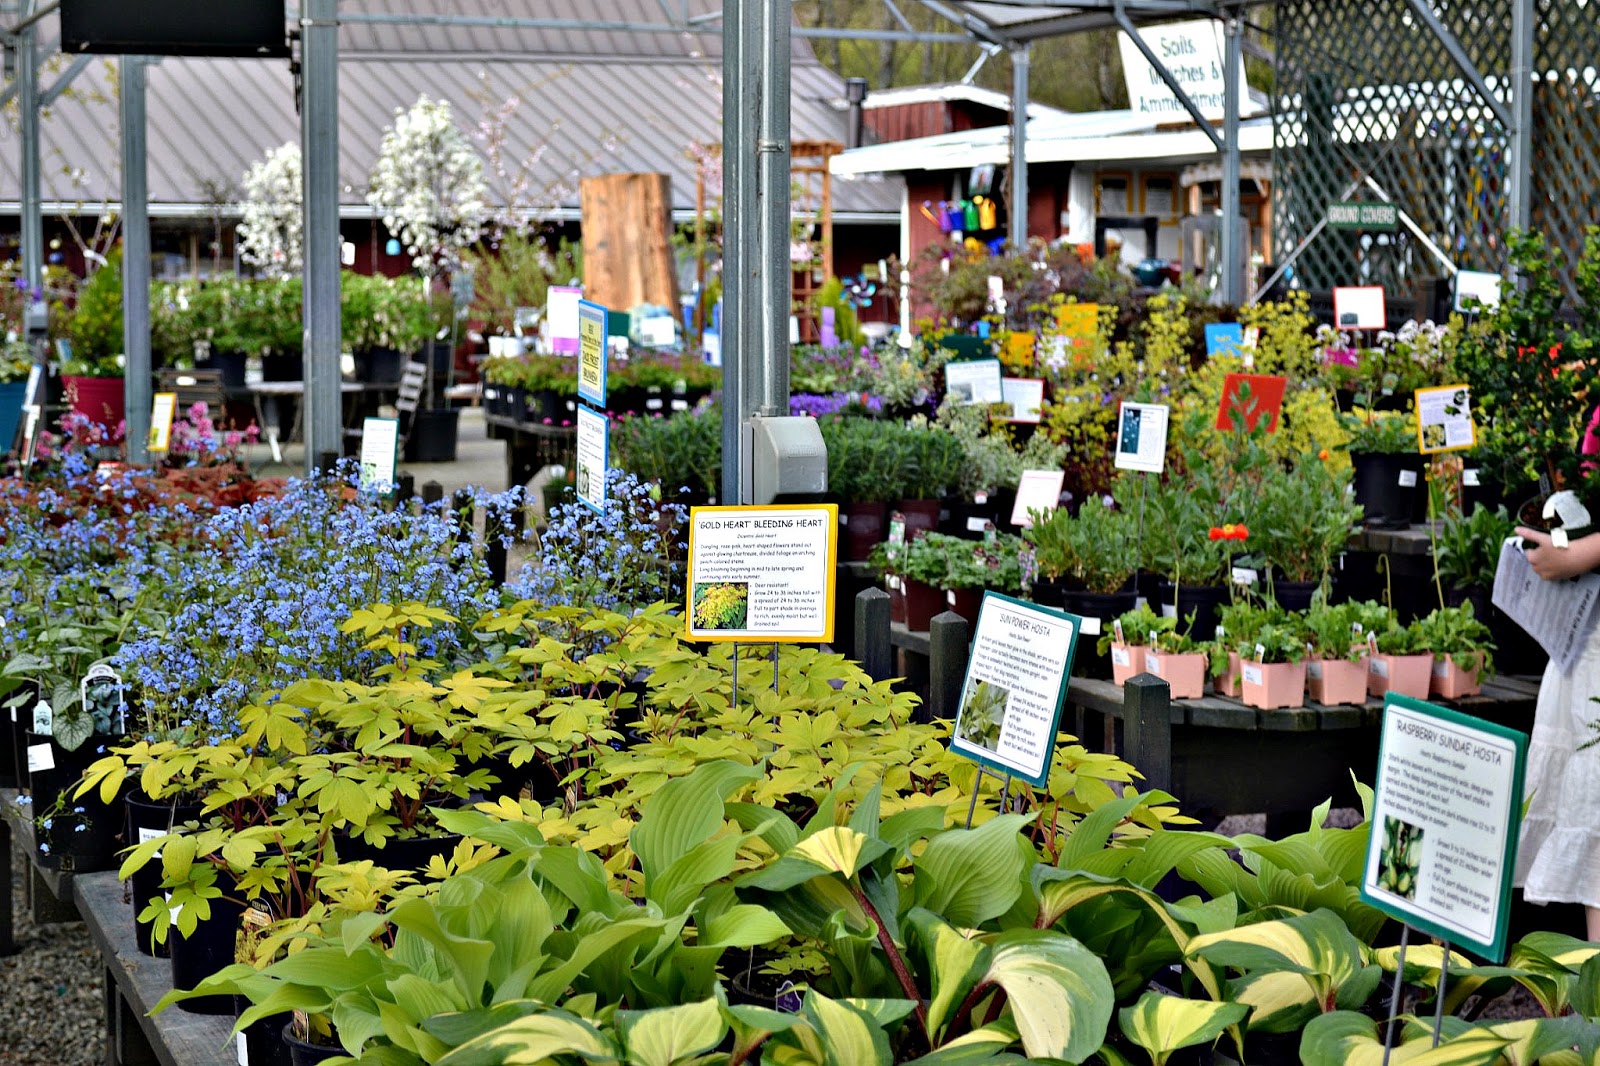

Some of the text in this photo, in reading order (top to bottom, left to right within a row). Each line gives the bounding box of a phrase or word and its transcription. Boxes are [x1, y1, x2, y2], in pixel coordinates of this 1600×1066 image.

[1161, 35, 1196, 57] Soils
[1328, 205, 1395, 224] GROUND COVERS
[754, 519, 792, 528] BLEEDING
[1030, 623, 1050, 636] HOSTA
[1473, 745, 1500, 765] HOSTA
